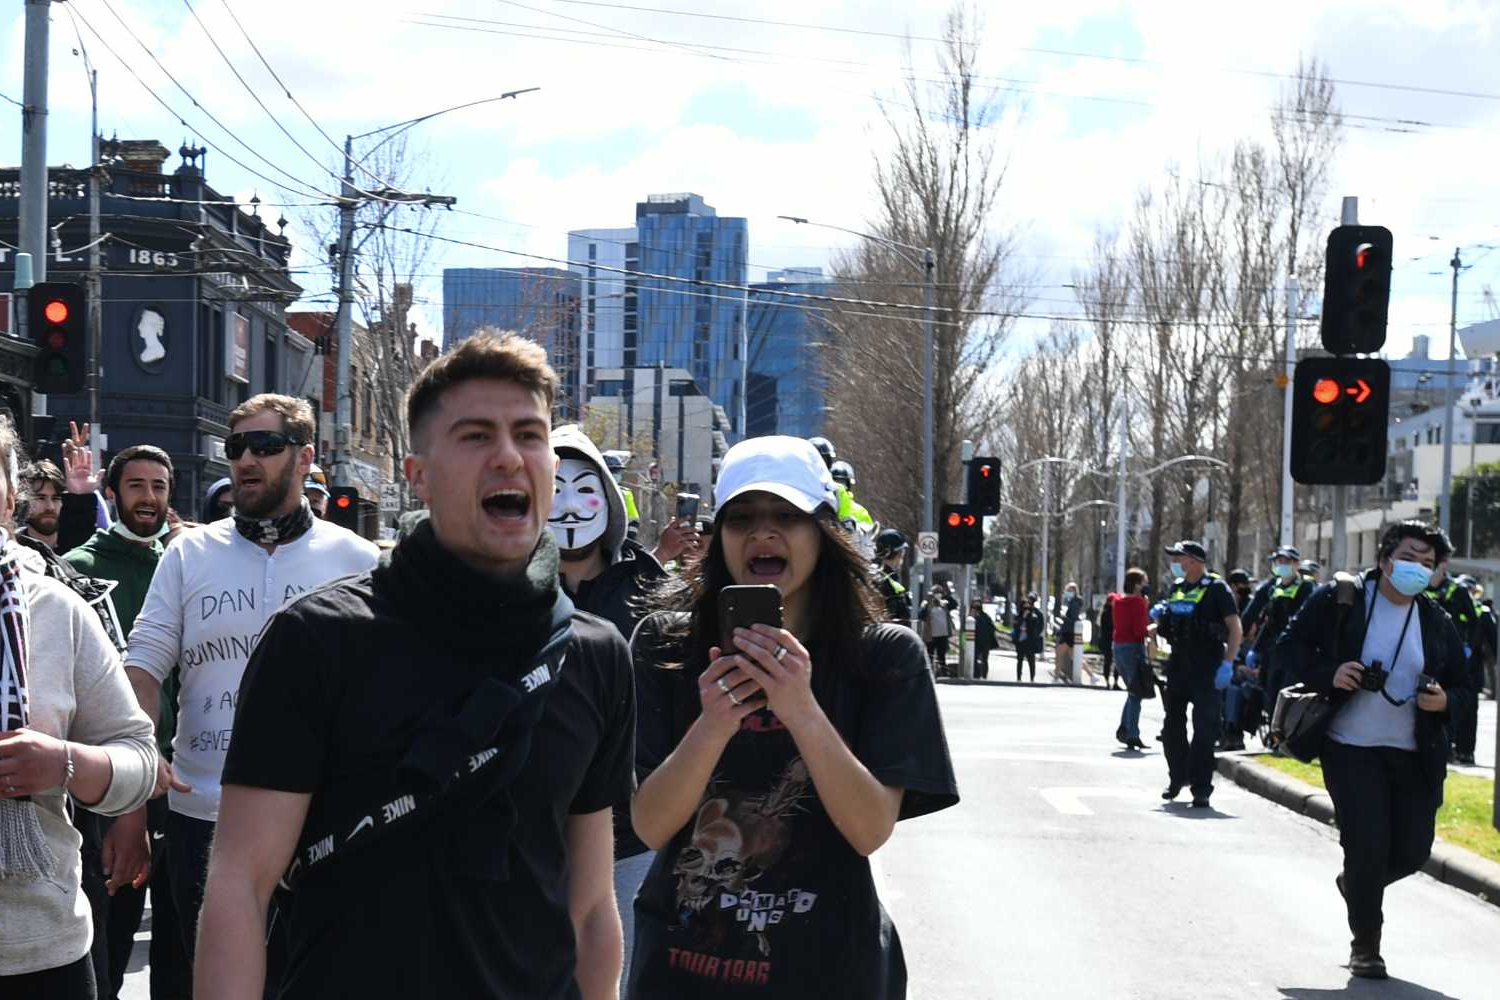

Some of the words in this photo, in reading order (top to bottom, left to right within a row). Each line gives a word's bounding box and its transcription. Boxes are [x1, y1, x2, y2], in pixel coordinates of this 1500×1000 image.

[201, 587, 257, 621] DAN
[520, 663, 552, 694] NIKE
[381, 793, 417, 825] NIKE
[307, 833, 335, 866] NIKE
[667, 947, 723, 978] TOUR
